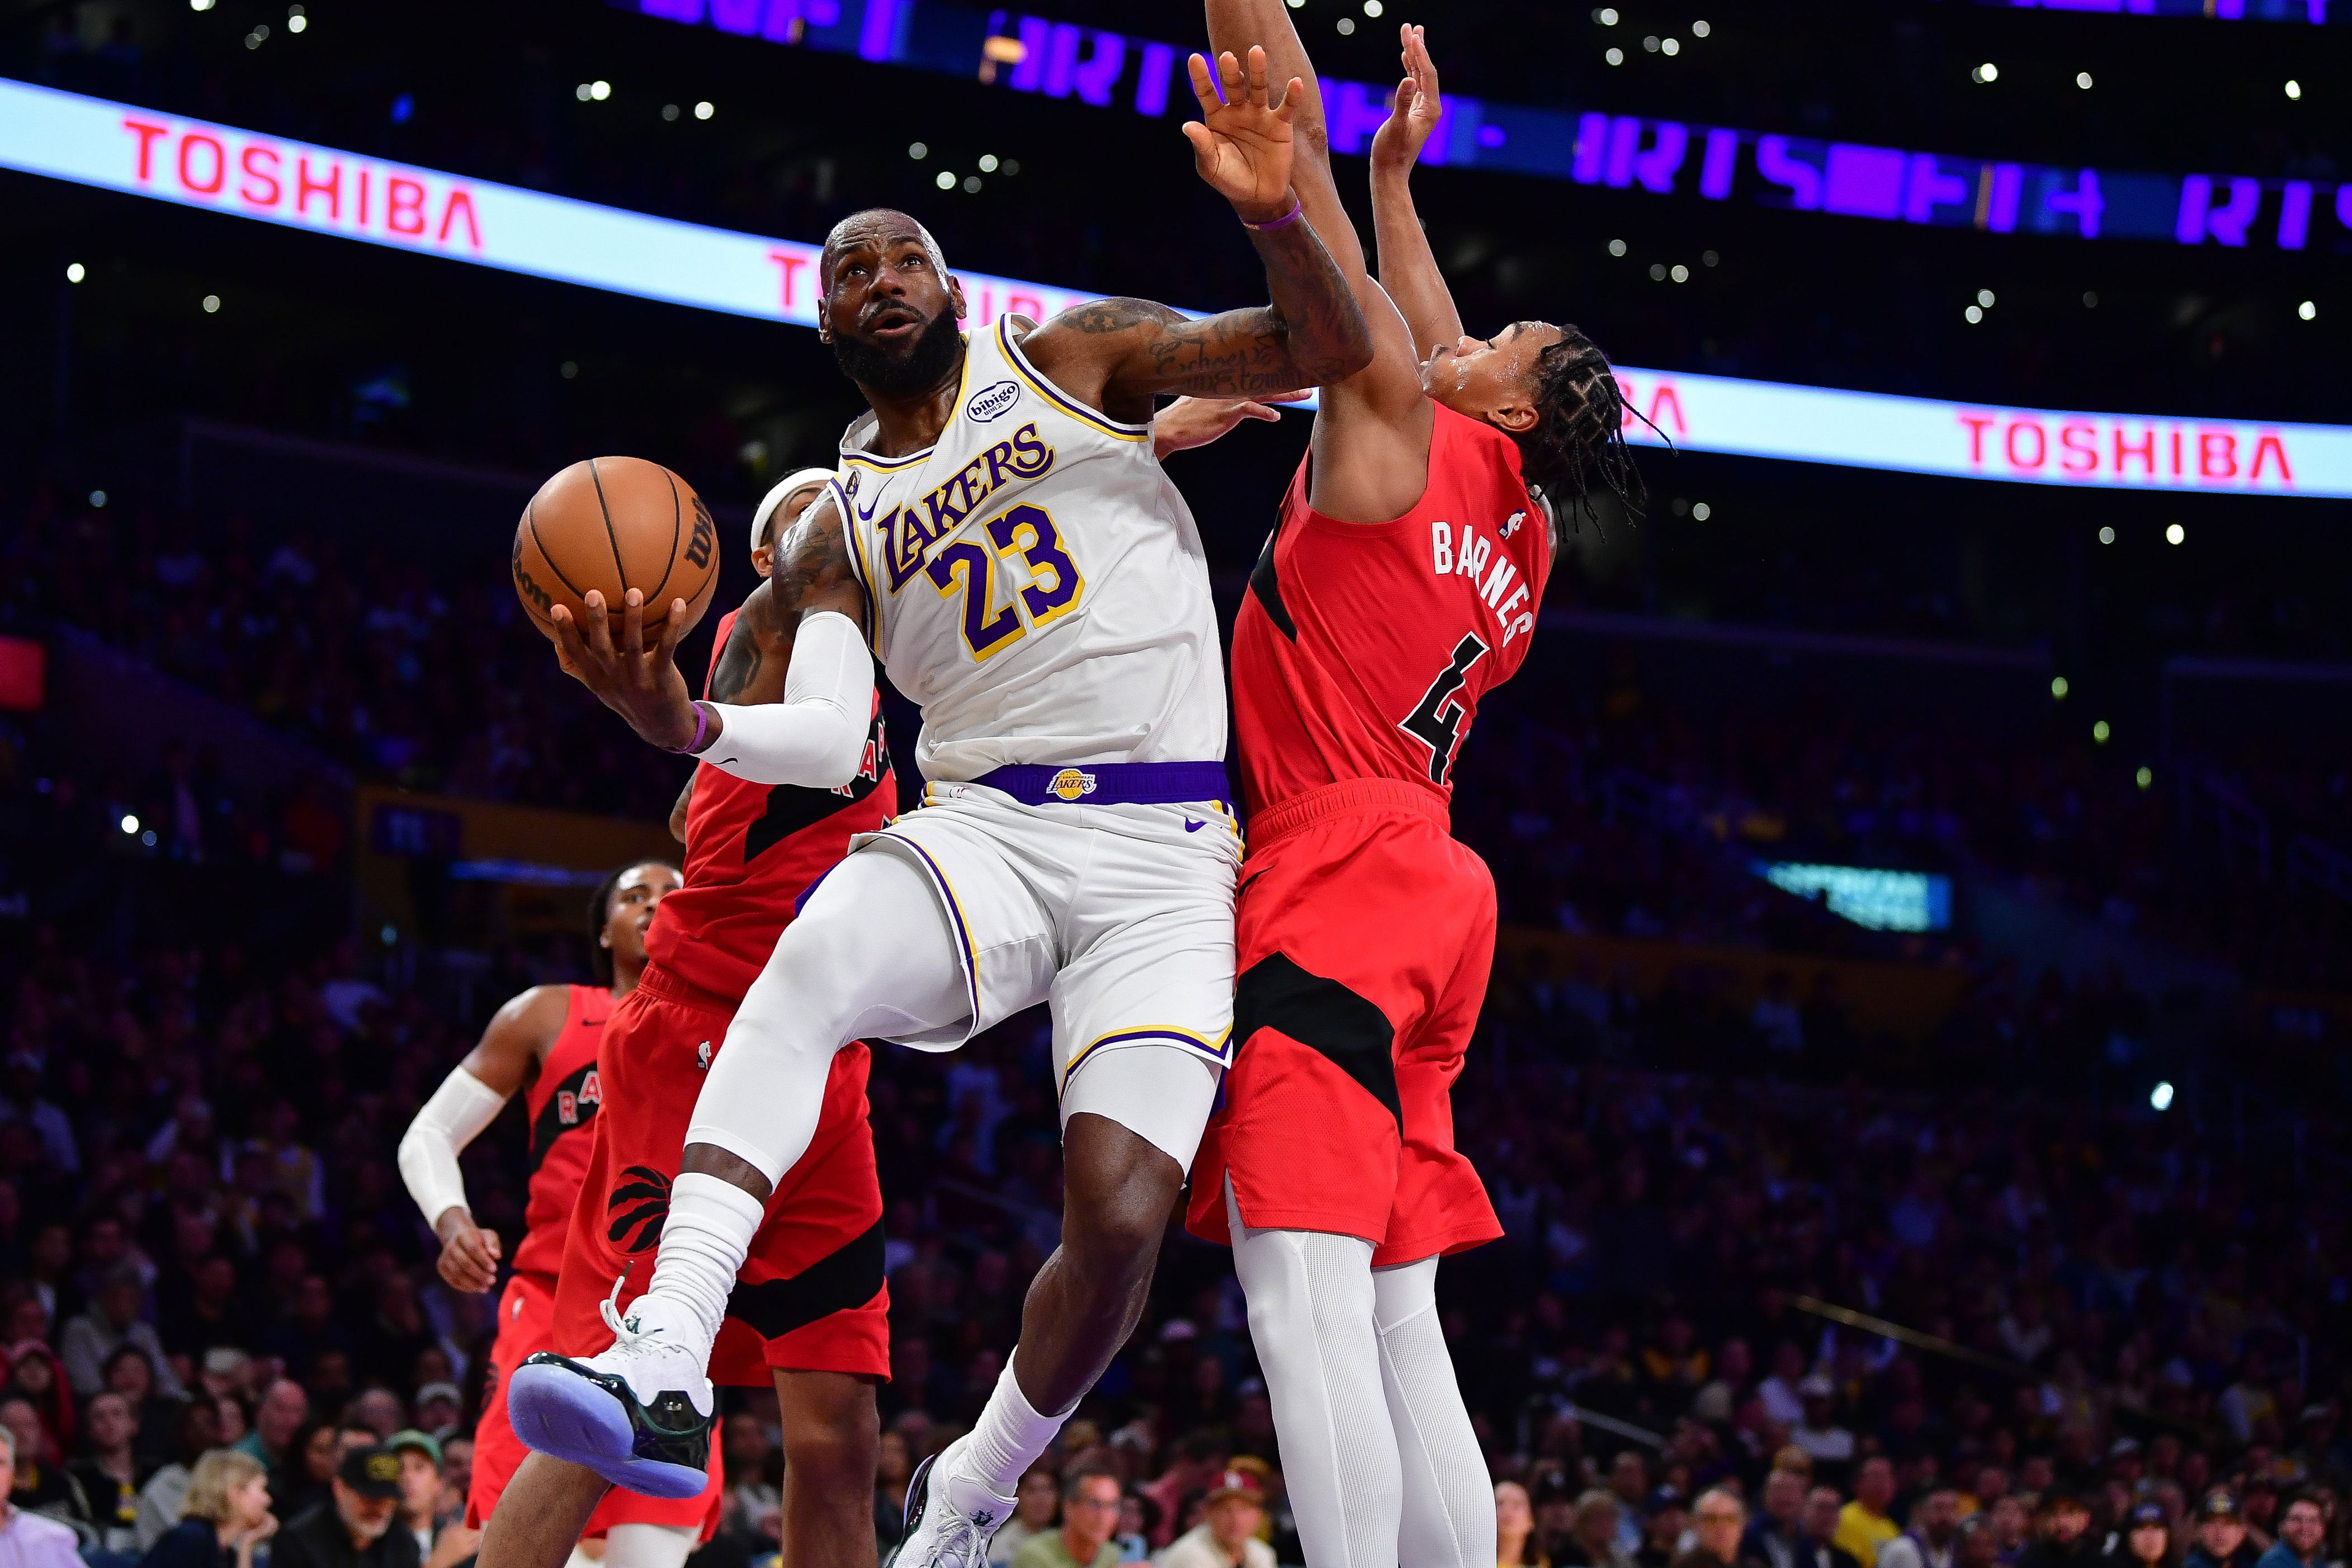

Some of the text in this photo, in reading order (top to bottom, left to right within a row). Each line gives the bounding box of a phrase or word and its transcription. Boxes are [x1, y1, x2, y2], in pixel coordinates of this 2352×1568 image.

[124, 119, 479, 248] TOSHIBA
[970, 386, 1016, 415] bibigo
[1961, 416, 2292, 481] TOSHIBA
[876, 421, 1056, 597] LAKERS
[923, 502, 1085, 663] 23
[1432, 522, 1532, 648] BARNES
[1398, 631, 1490, 785] 4
[1046, 776, 1095, 792] LAKERS
